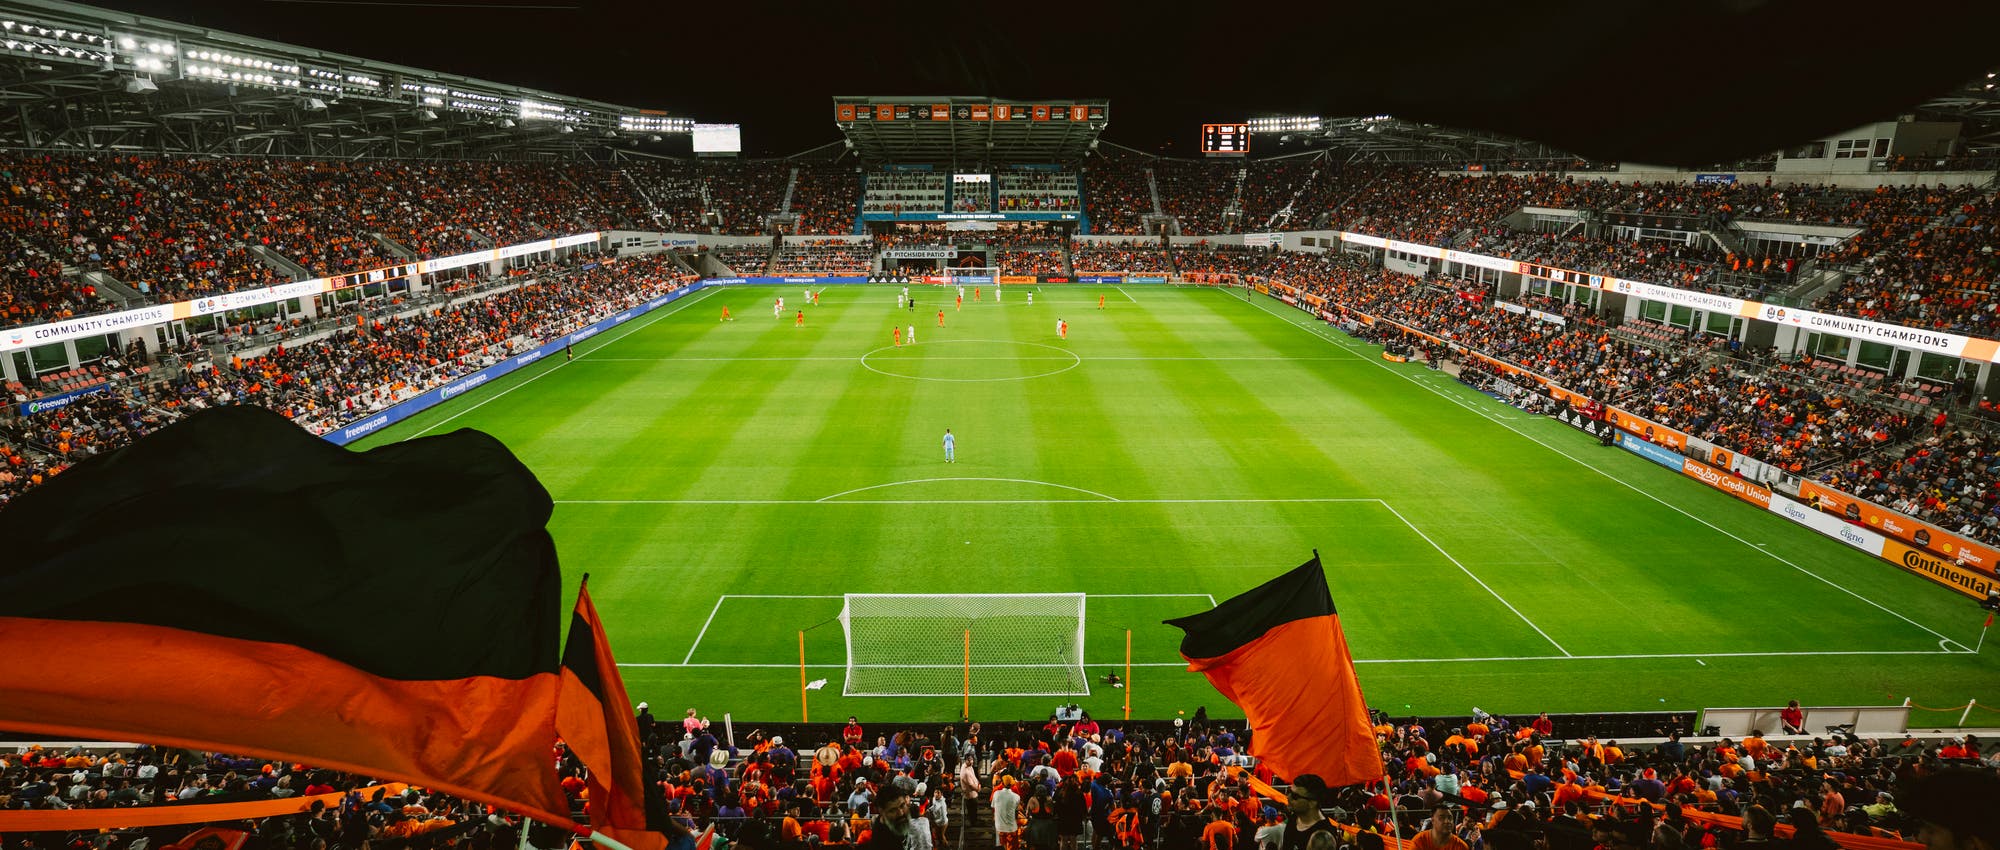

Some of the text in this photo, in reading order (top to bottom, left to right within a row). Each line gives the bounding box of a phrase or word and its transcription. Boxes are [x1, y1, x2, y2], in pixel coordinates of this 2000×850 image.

[1647, 288, 1733, 310] COMMUNITY CHAMPIONS
[35, 310, 163, 339] COMMUNITY CHAMPIONS
[1810, 316, 1949, 348] COMMUNITY CHAMPIONS
[38, 396, 70, 410] Freeway
[345, 415, 388, 439] freeway.com
[1684, 458, 1770, 504] Texas Bay Credit Union
[1784, 505, 1806, 520] cigna
[1840, 527, 1864, 544] cigna
[1903, 550, 1993, 596] Continental
